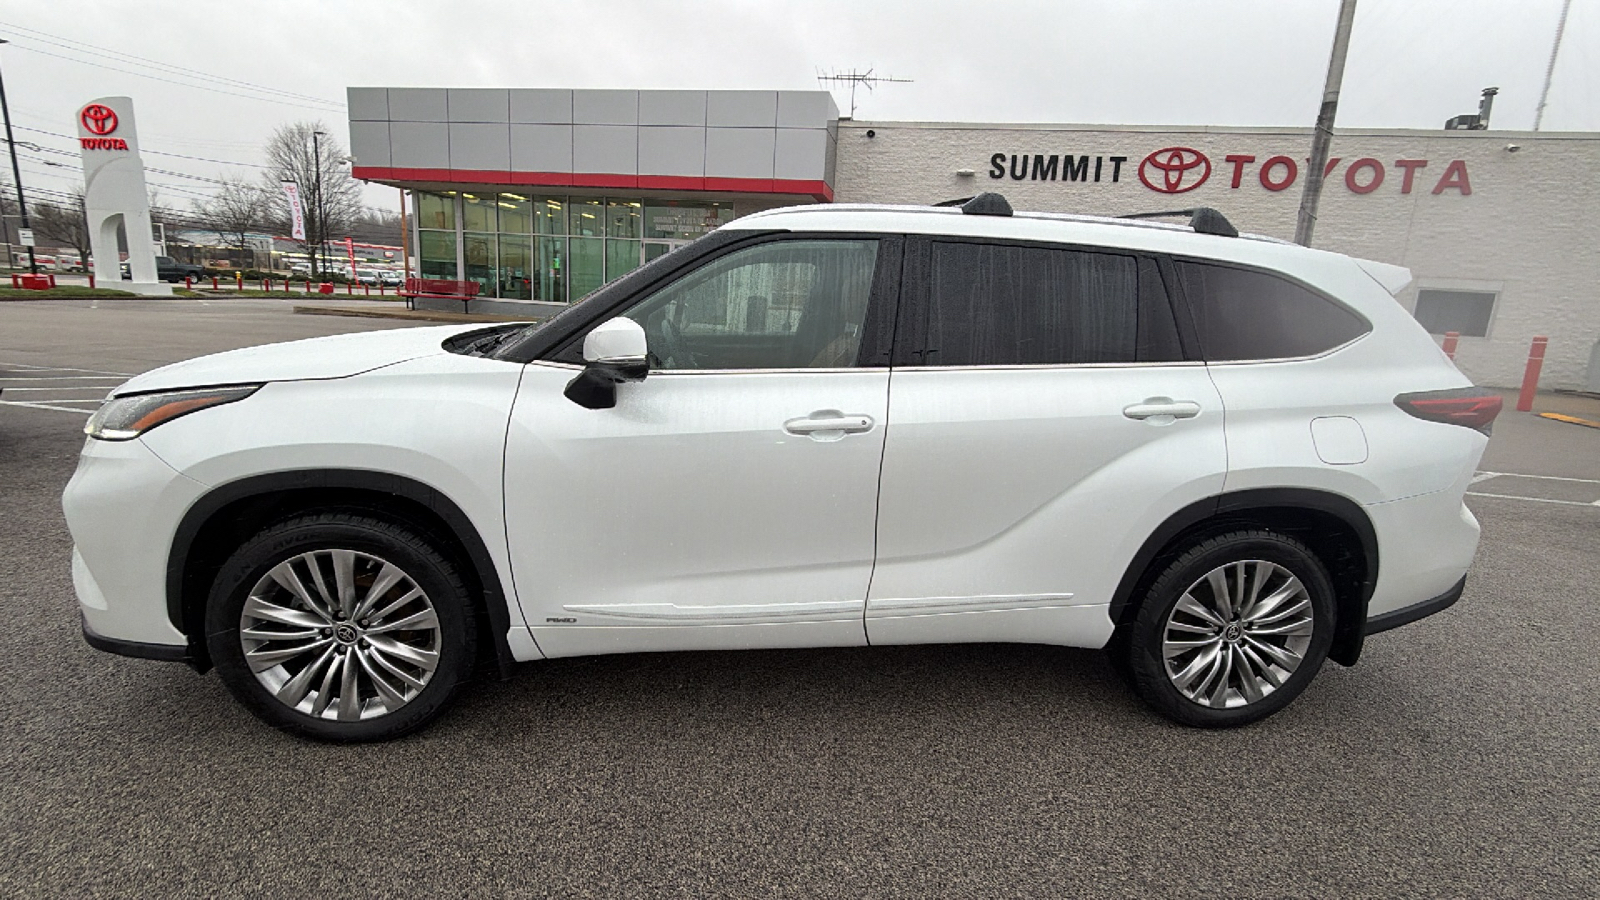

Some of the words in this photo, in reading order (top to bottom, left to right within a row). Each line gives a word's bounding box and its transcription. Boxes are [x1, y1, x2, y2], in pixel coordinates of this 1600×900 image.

[79, 138, 129, 151] TOYOTA
[989, 152, 1127, 183] SUMMIT
[290, 194, 303, 236] TOYOTA
